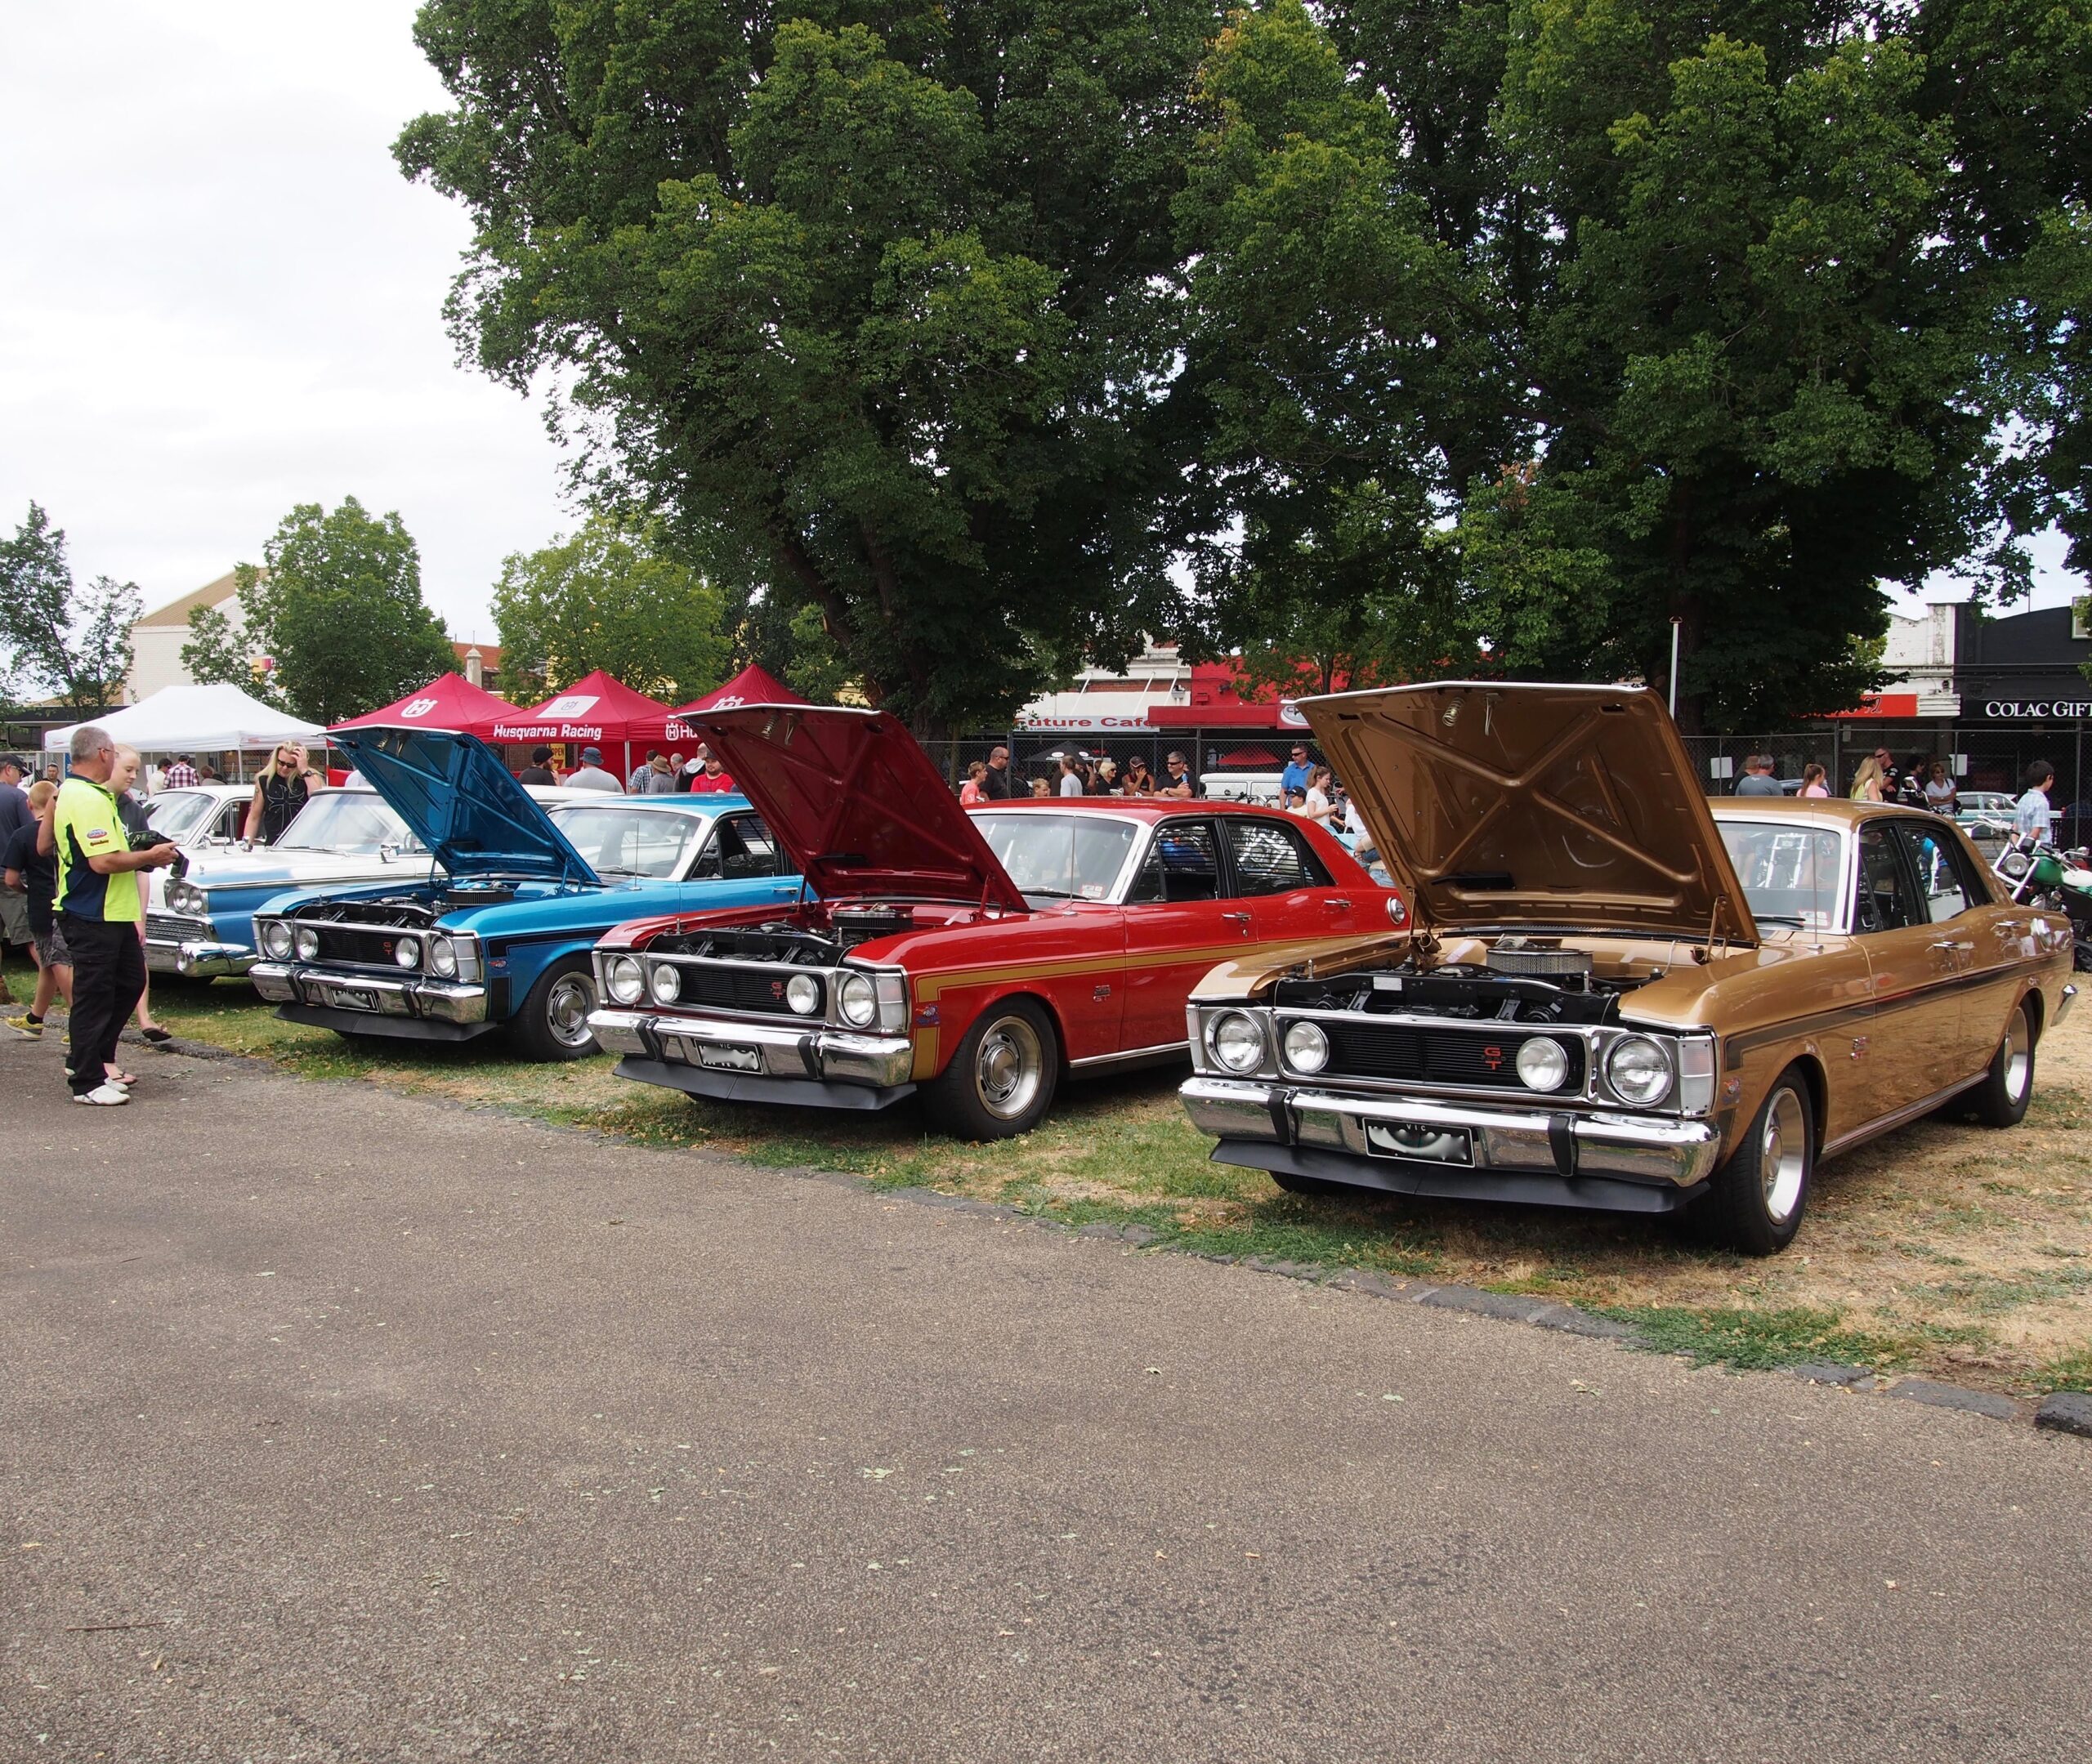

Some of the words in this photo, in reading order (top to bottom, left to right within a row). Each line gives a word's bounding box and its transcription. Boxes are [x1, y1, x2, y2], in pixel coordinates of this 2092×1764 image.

[1985, 701, 2050, 717] COLAC
[1013, 718, 1092, 726] Future
[494, 724, 557, 740] Husqvarna
[561, 724, 602, 740] Racing
[1484, 1047, 1502, 1070] GT
[1406, 1123, 1427, 1132] VIC
